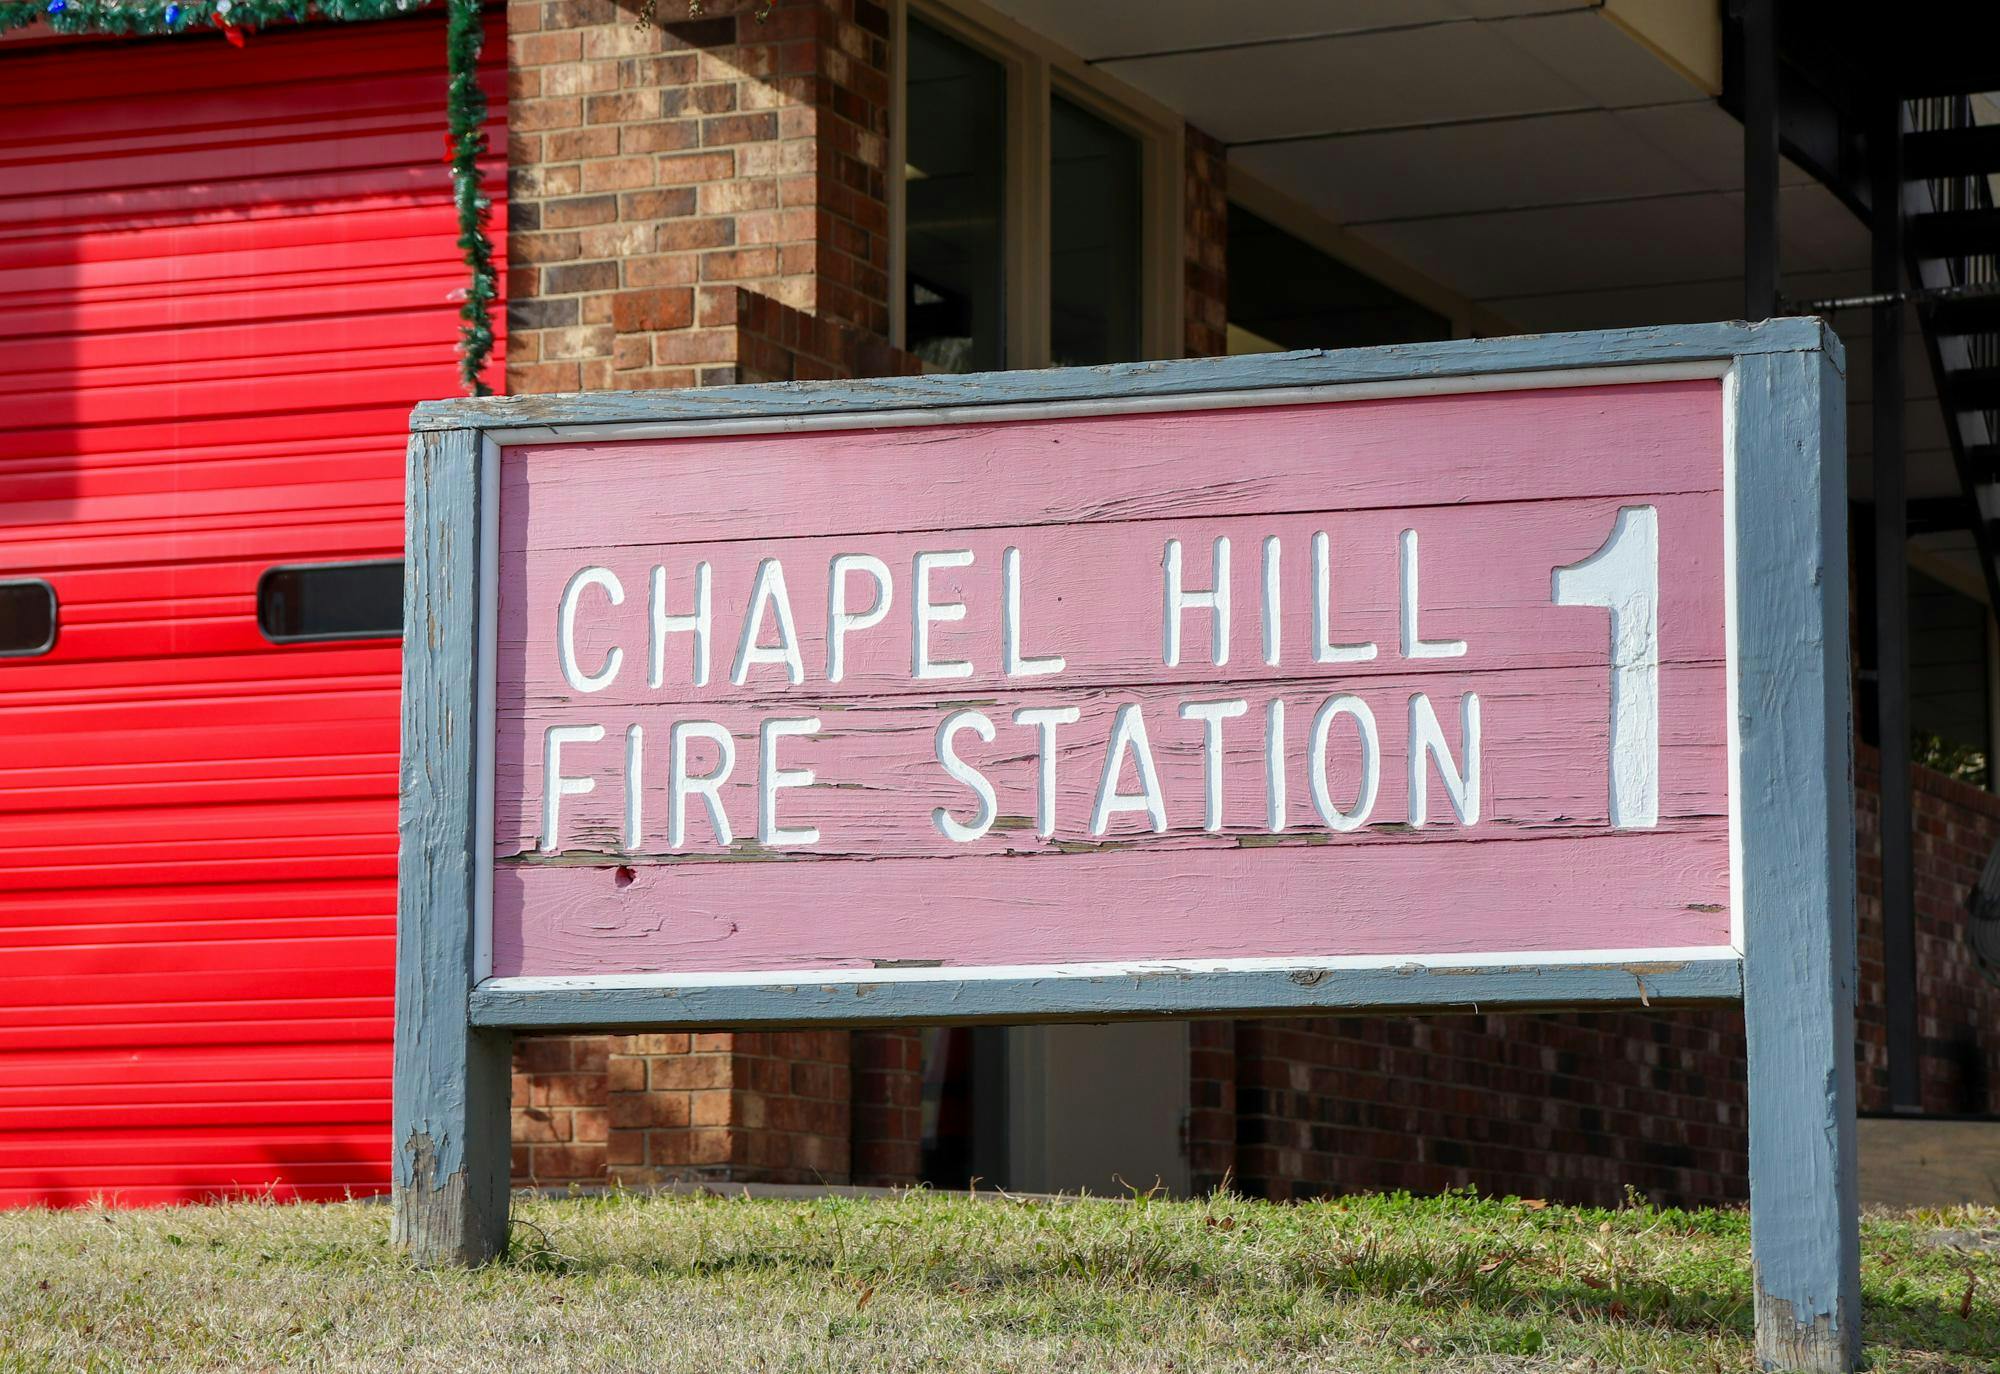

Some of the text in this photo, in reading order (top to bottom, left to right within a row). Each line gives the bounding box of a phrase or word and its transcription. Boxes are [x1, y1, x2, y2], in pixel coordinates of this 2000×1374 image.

[558, 528, 1468, 693] CHAPEL HILL
[1552, 506, 1660, 830] 1
[541, 692, 1482, 853] FIRE STATION
